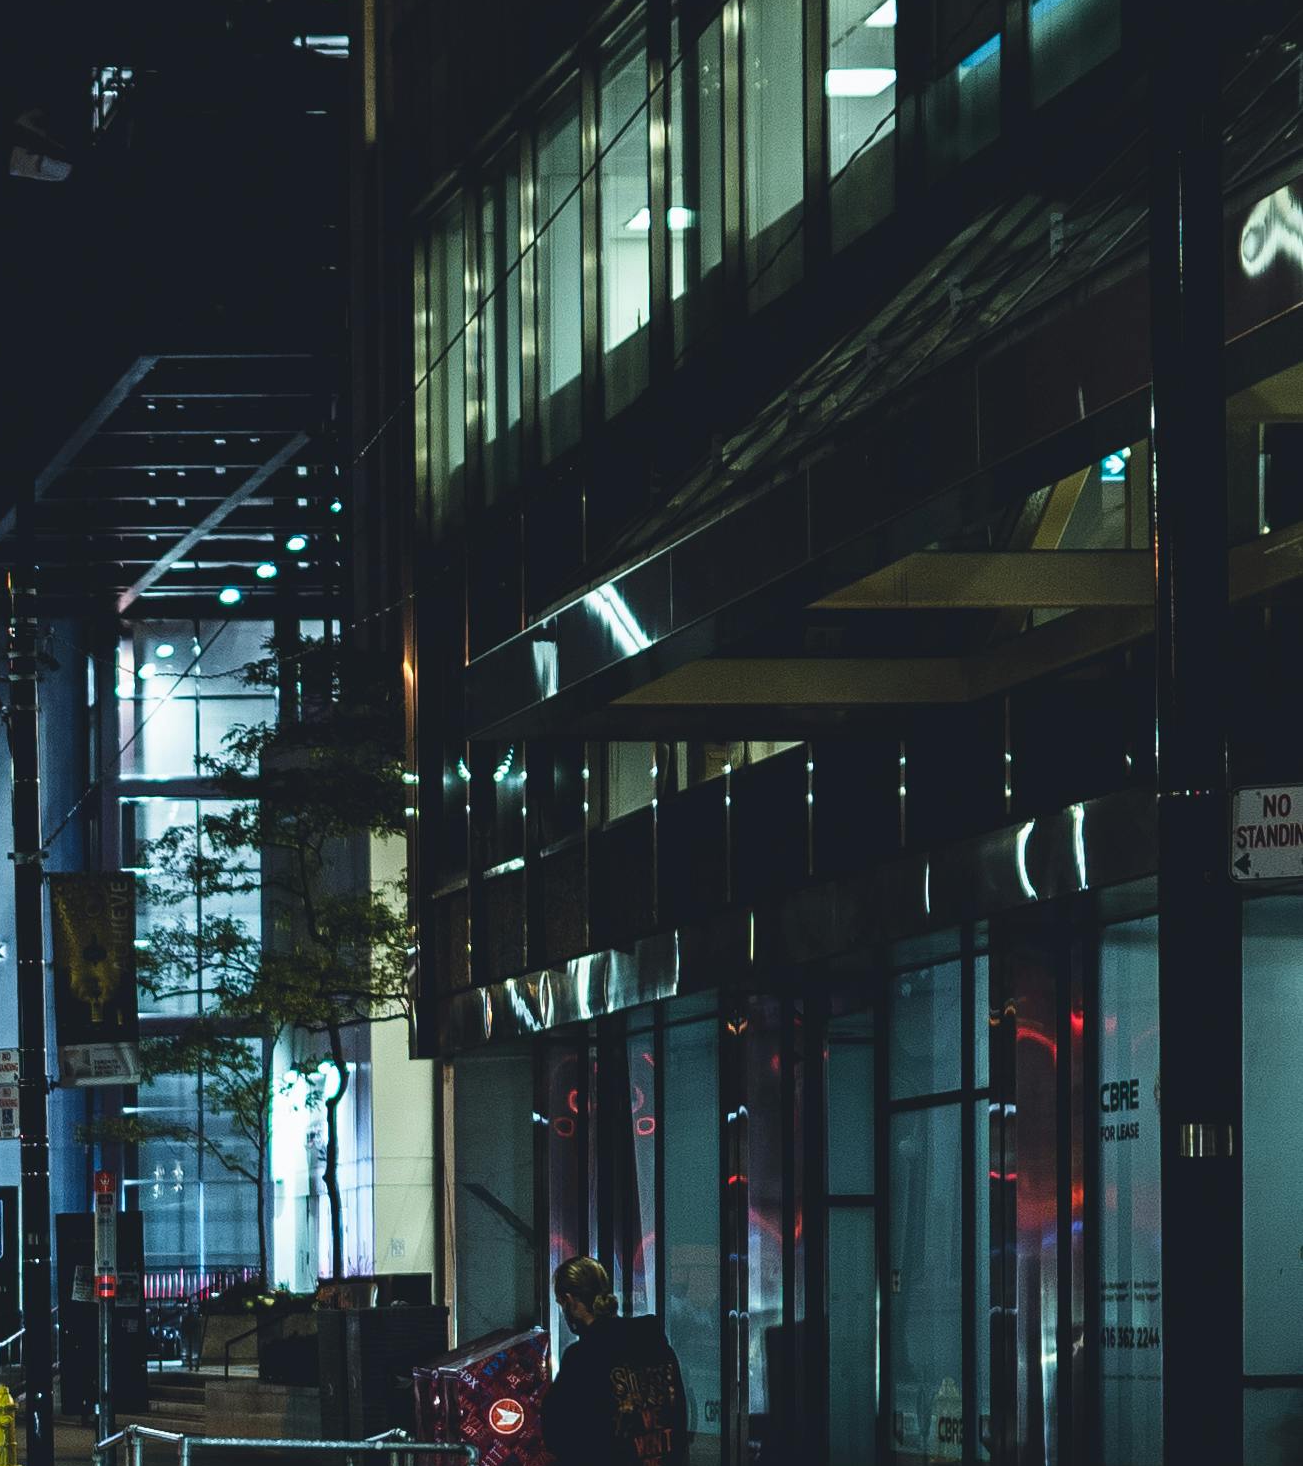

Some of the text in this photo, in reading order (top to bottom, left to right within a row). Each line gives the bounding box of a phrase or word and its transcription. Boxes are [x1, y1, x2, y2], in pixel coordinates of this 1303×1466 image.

[1263, 794, 1291, 818] NO
[1100, 1079, 1139, 1112] CBRE
[1100, 1122, 1139, 1142] FOR LEASE
